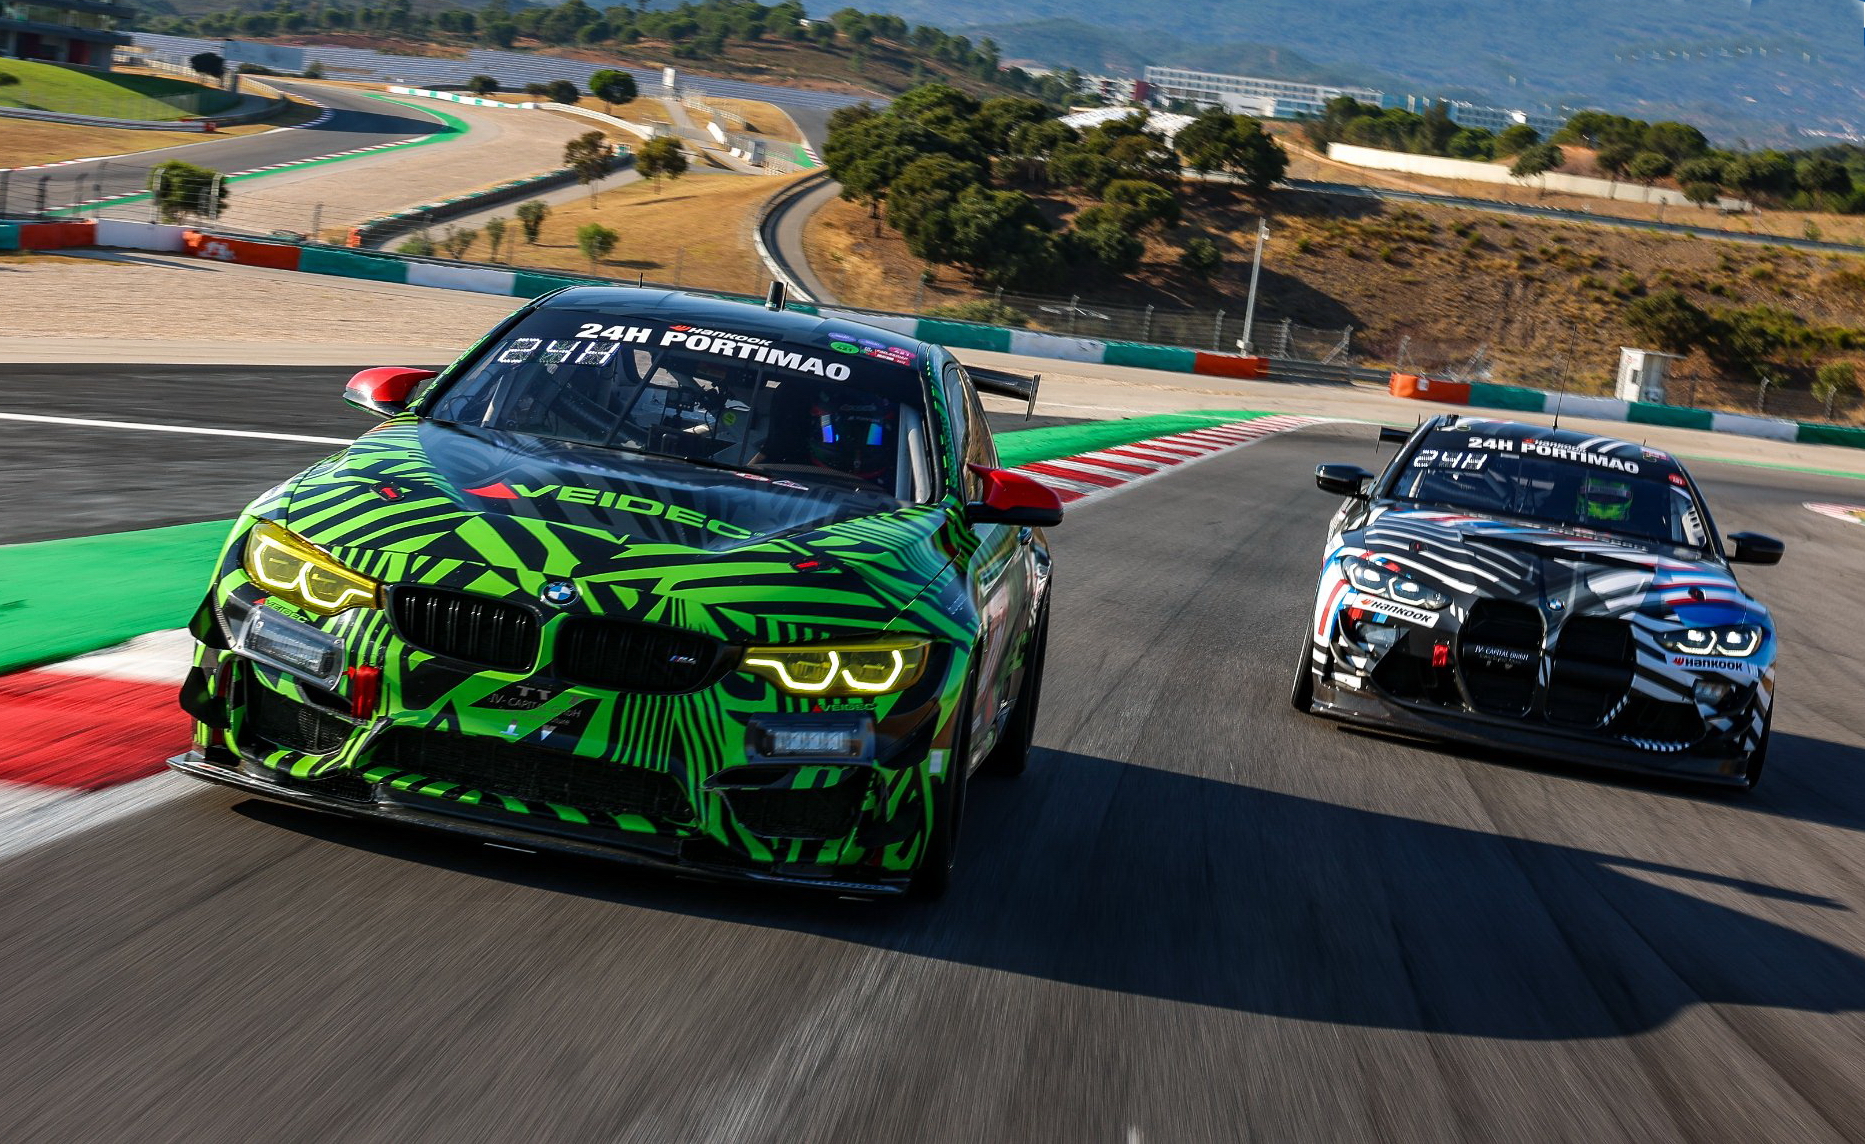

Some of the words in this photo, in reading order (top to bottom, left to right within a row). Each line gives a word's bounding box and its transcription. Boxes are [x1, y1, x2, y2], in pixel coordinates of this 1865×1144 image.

[575, 323, 652, 343] 24H
[660, 331, 851, 382] PORTIMAO
[1468, 436, 1514, 452] 24H
[1521, 441, 1640, 475] PORTIMAO
[510, 484, 752, 540] VEIDEC
[263, 599, 308, 624] VEIDEC
[822, 703, 876, 712] VEIDEC
